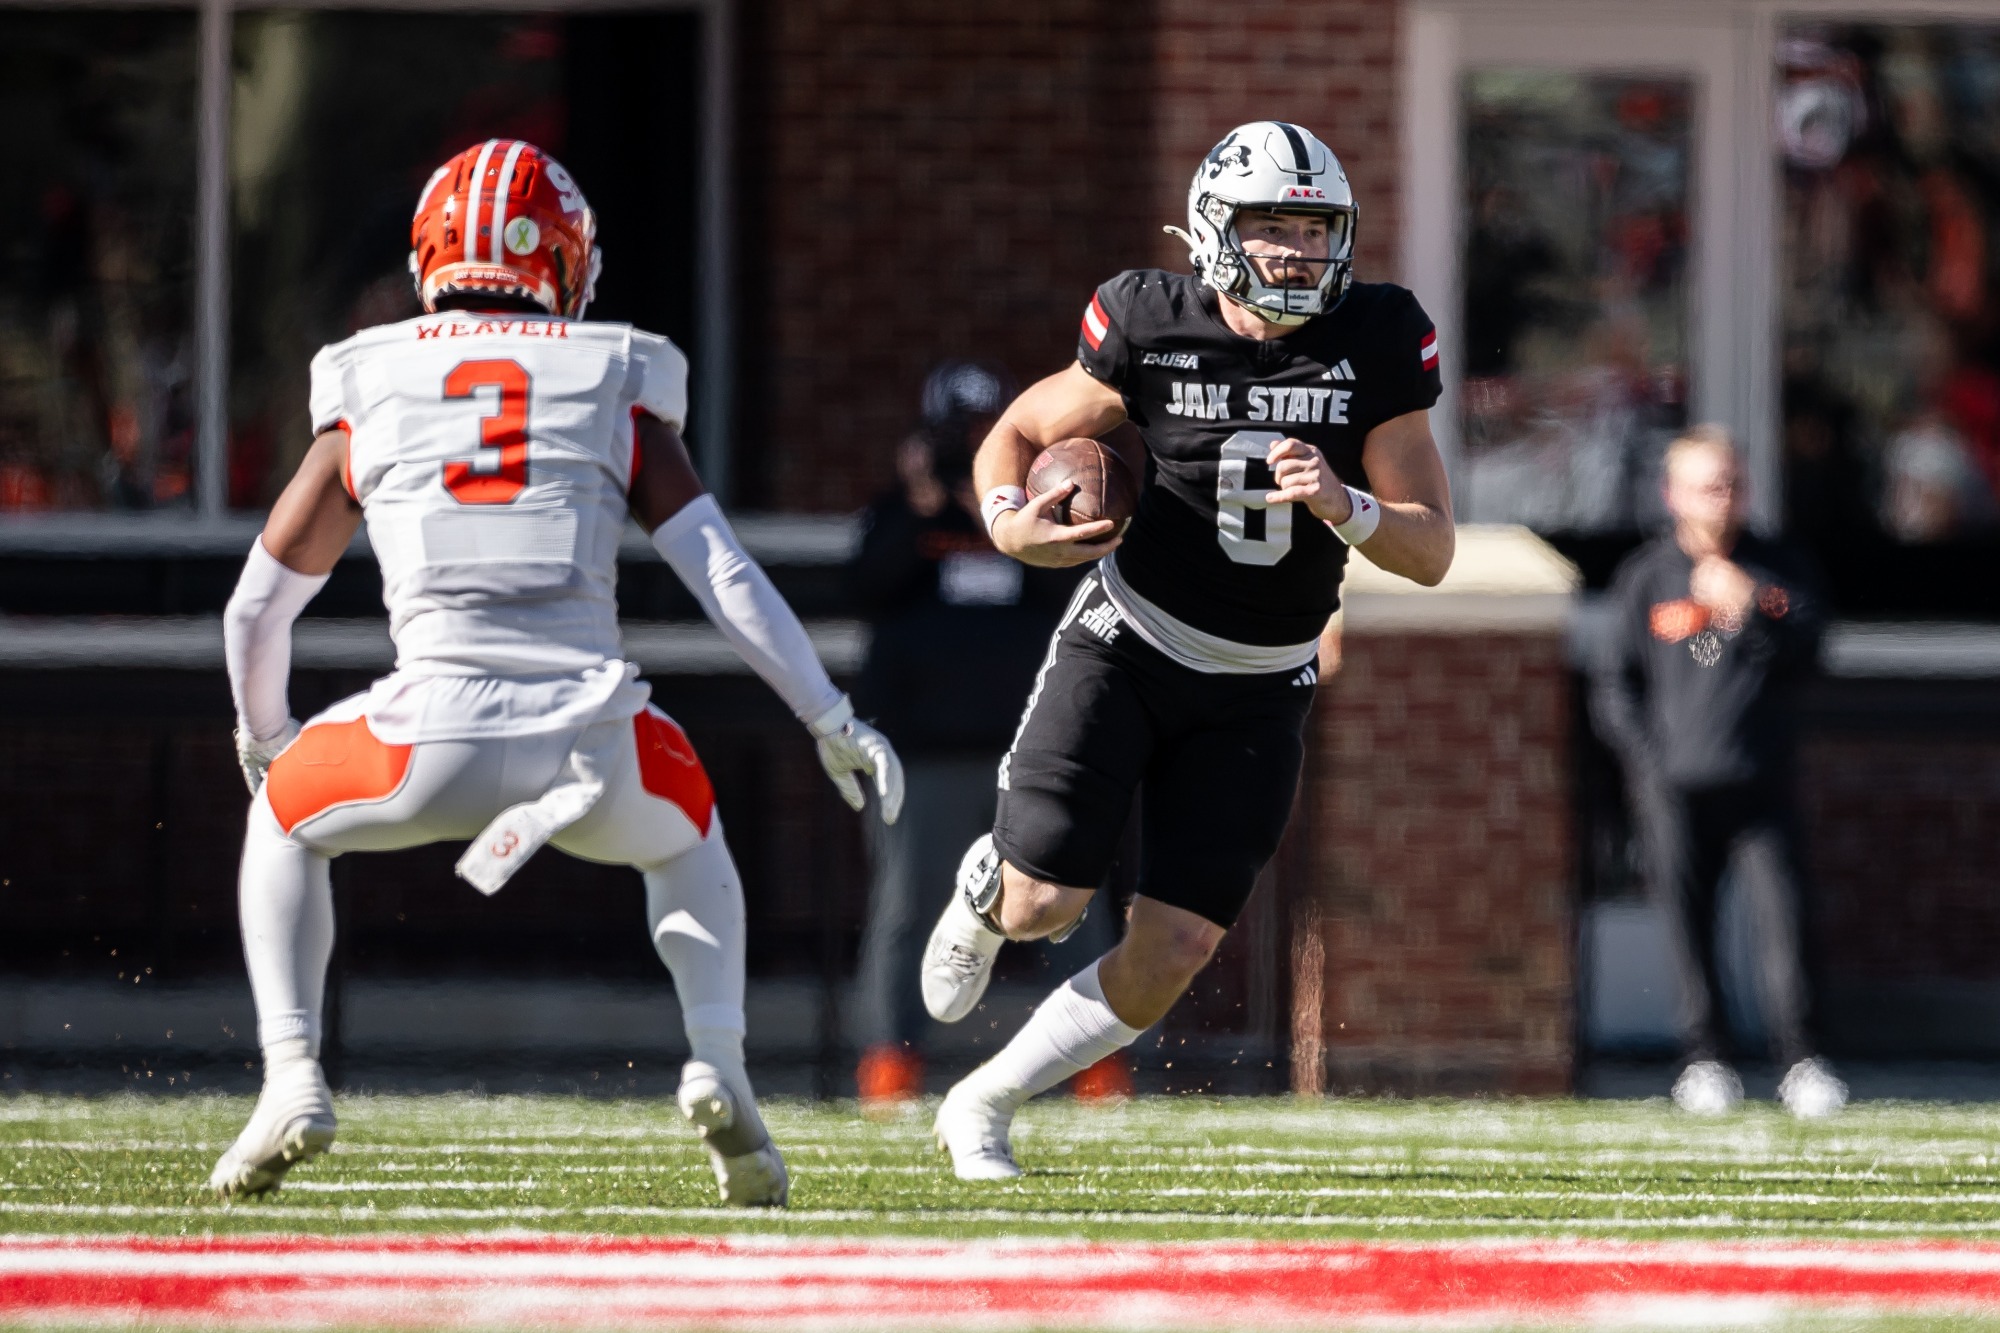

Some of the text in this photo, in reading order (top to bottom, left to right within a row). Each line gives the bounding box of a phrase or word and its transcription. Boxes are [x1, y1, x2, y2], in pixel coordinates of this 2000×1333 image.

[1166, 381, 1352, 424] JAX STATE
[442, 358, 531, 505] 3
[1078, 608, 1120, 645] STATE
[491, 829, 520, 858] 3
